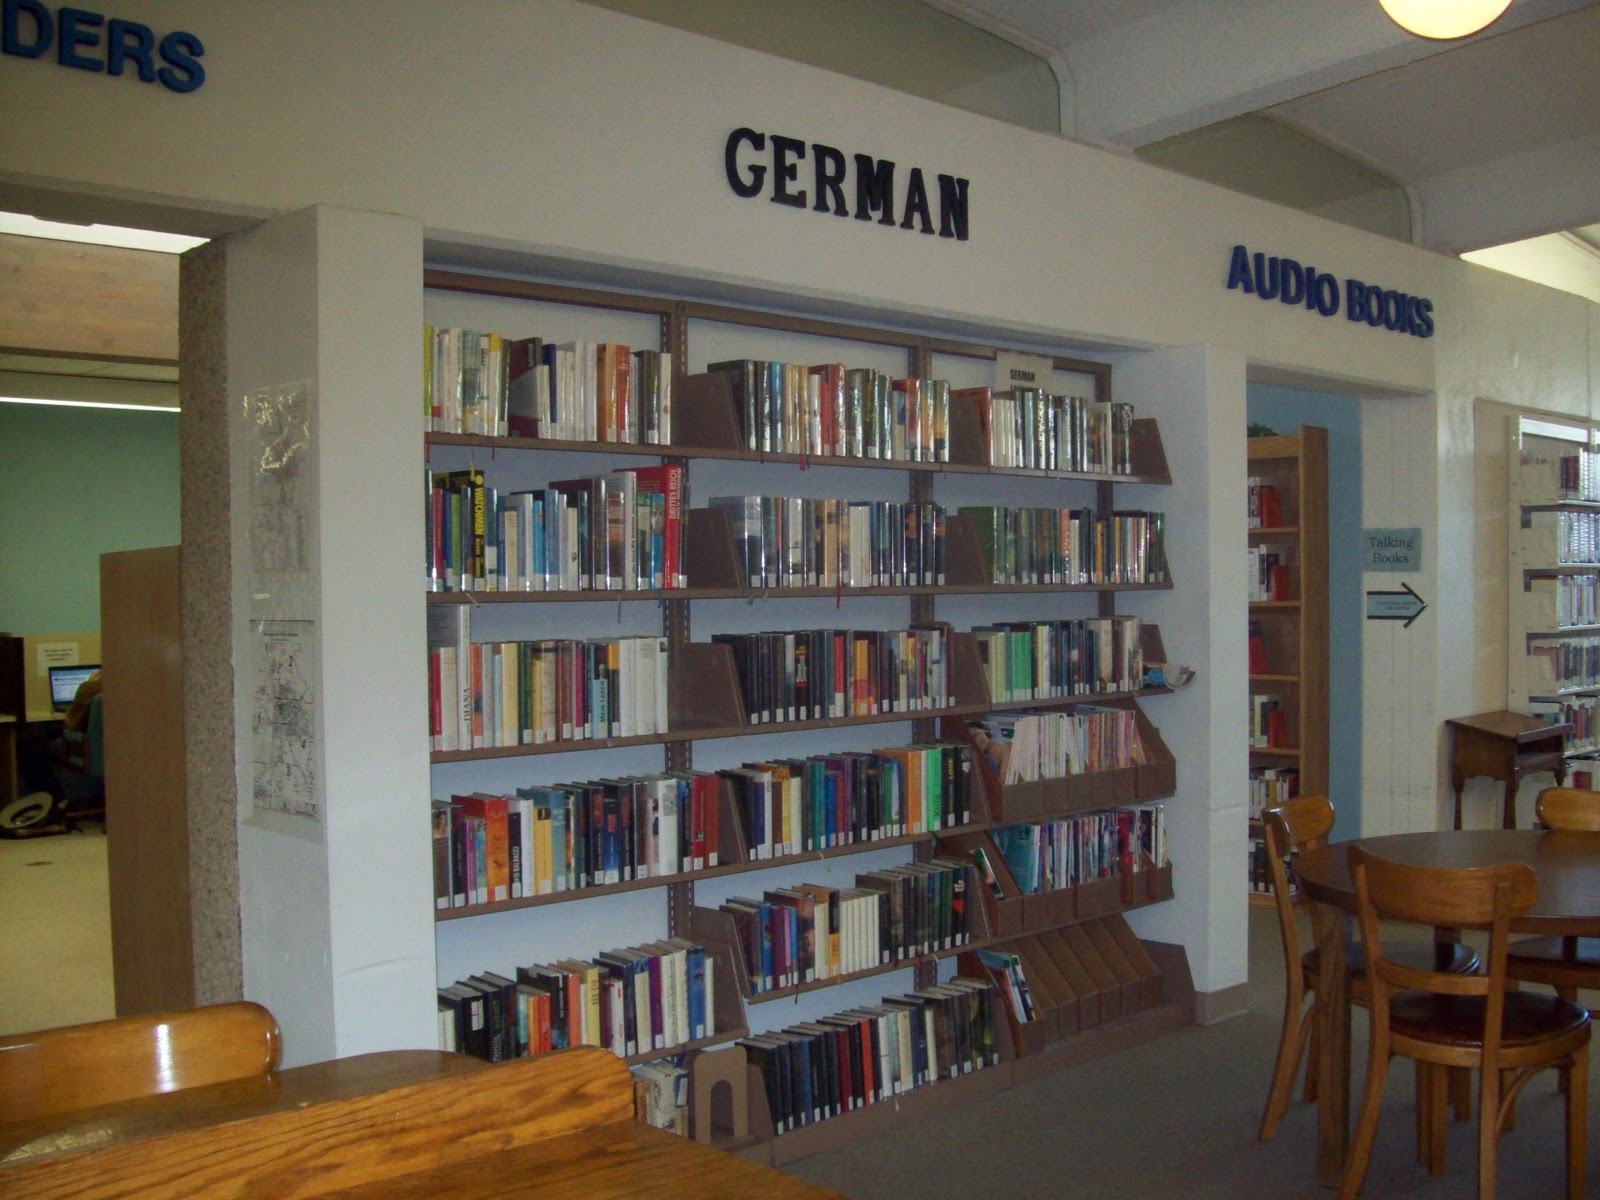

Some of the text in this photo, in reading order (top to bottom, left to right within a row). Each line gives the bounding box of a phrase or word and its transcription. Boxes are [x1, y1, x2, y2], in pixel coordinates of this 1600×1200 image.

[2, 0, 206, 93] DERS
[725, 127, 969, 241] GERMAN
[1227, 245, 1435, 338] AUDIO BOOKS
[1010, 369, 1036, 383] GERMAN
[475, 487, 484, 535] WATCHMEN
[1369, 537, 1414, 550] Talking
[1373, 553, 1409, 564] Books
[463, 687, 471, 721] DIANA
